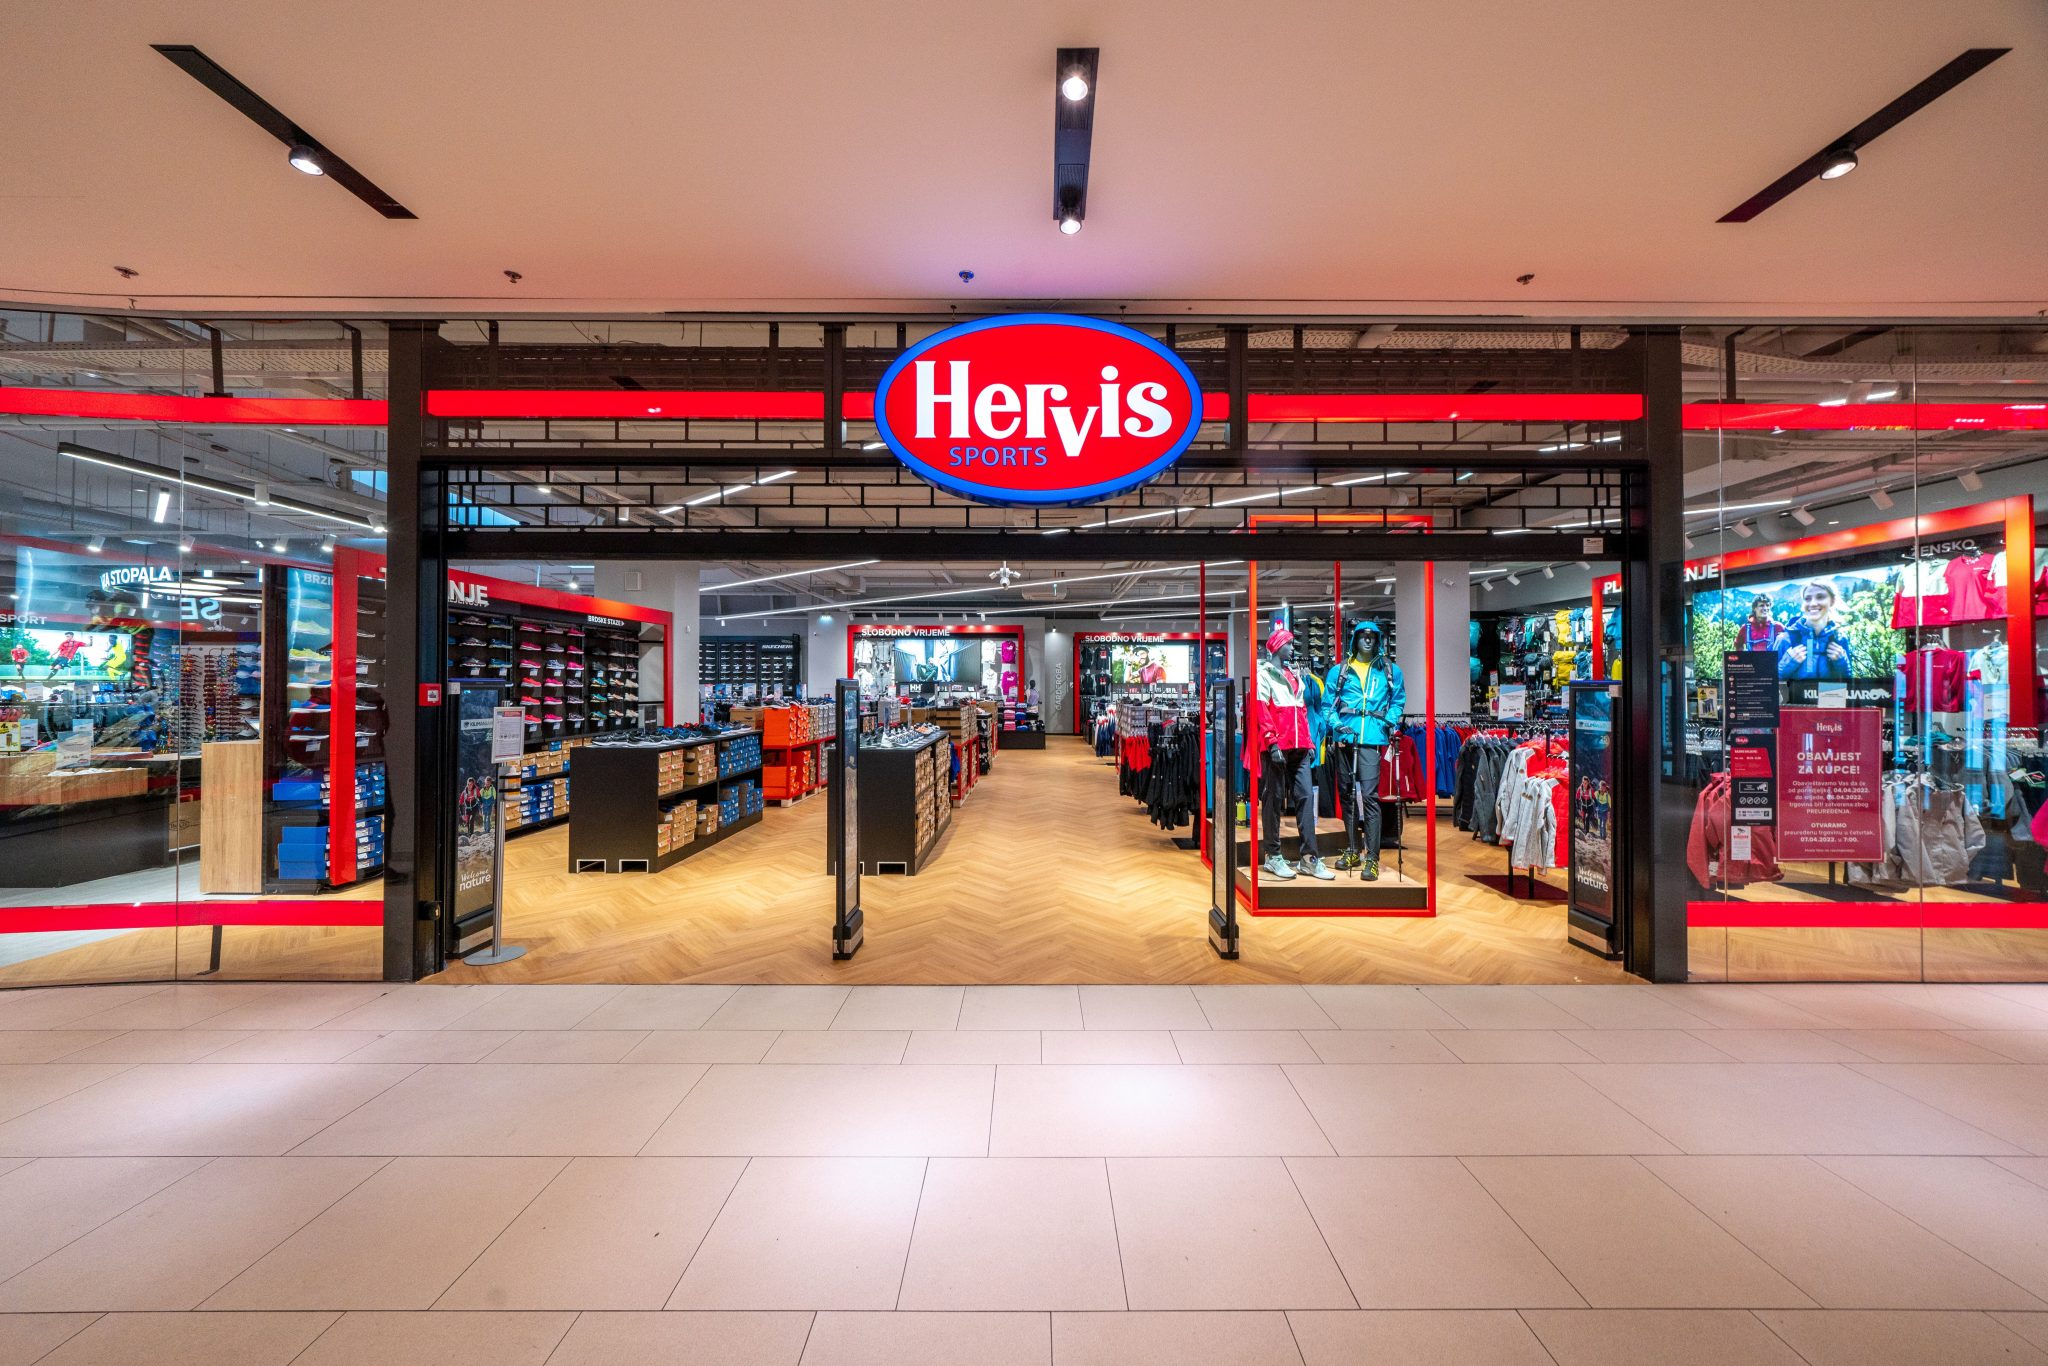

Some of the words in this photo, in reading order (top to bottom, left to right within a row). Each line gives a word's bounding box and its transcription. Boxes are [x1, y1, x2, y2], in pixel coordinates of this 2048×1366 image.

[914, 360, 1173, 457] Hervis
[949, 446, 1048, 467] SPORTS
[110, 566, 172, 586] STOPALA
[1684, 563, 1719, 582] NJE
[448, 579, 488, 605] NJE
[0, 613, 48, 625] SPORT
[861, 628, 911, 637] SLOBODNO
[913, 629, 950, 637] VRIJEME
[1131, 635, 1164, 643] VRIJEME
[1055, 663, 1063, 711] GARDEROBA
[1816, 722, 1843, 734] Hervis
[1797, 752, 1861, 761] OBAVIJEST
[1798, 765, 1813, 775] ZA
[1817, 765, 1860, 775] KUPCE!
[459, 874, 492, 892] nature
[1577, 874, 1609, 892] nature
